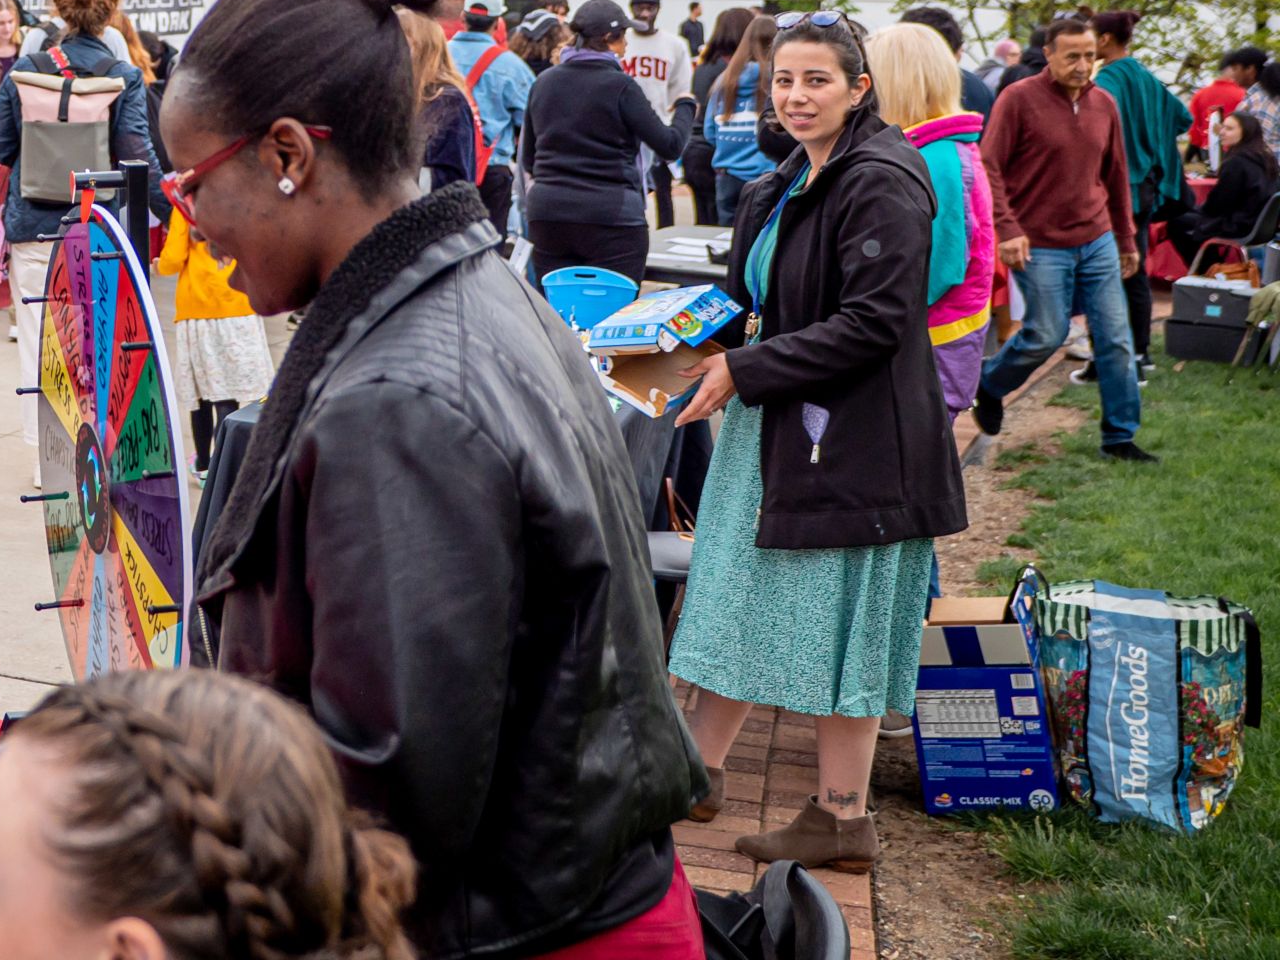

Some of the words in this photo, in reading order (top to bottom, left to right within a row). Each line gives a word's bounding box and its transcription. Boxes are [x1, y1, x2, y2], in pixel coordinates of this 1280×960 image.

[622, 56, 667, 81] MSU
[43, 334, 72, 415] STRESS
[1120, 644, 1150, 801] HomeGoods
[959, 796, 1000, 806] CLASSIC
[1003, 796, 1022, 806] MIX
[1032, 794, 1051, 805] 50
